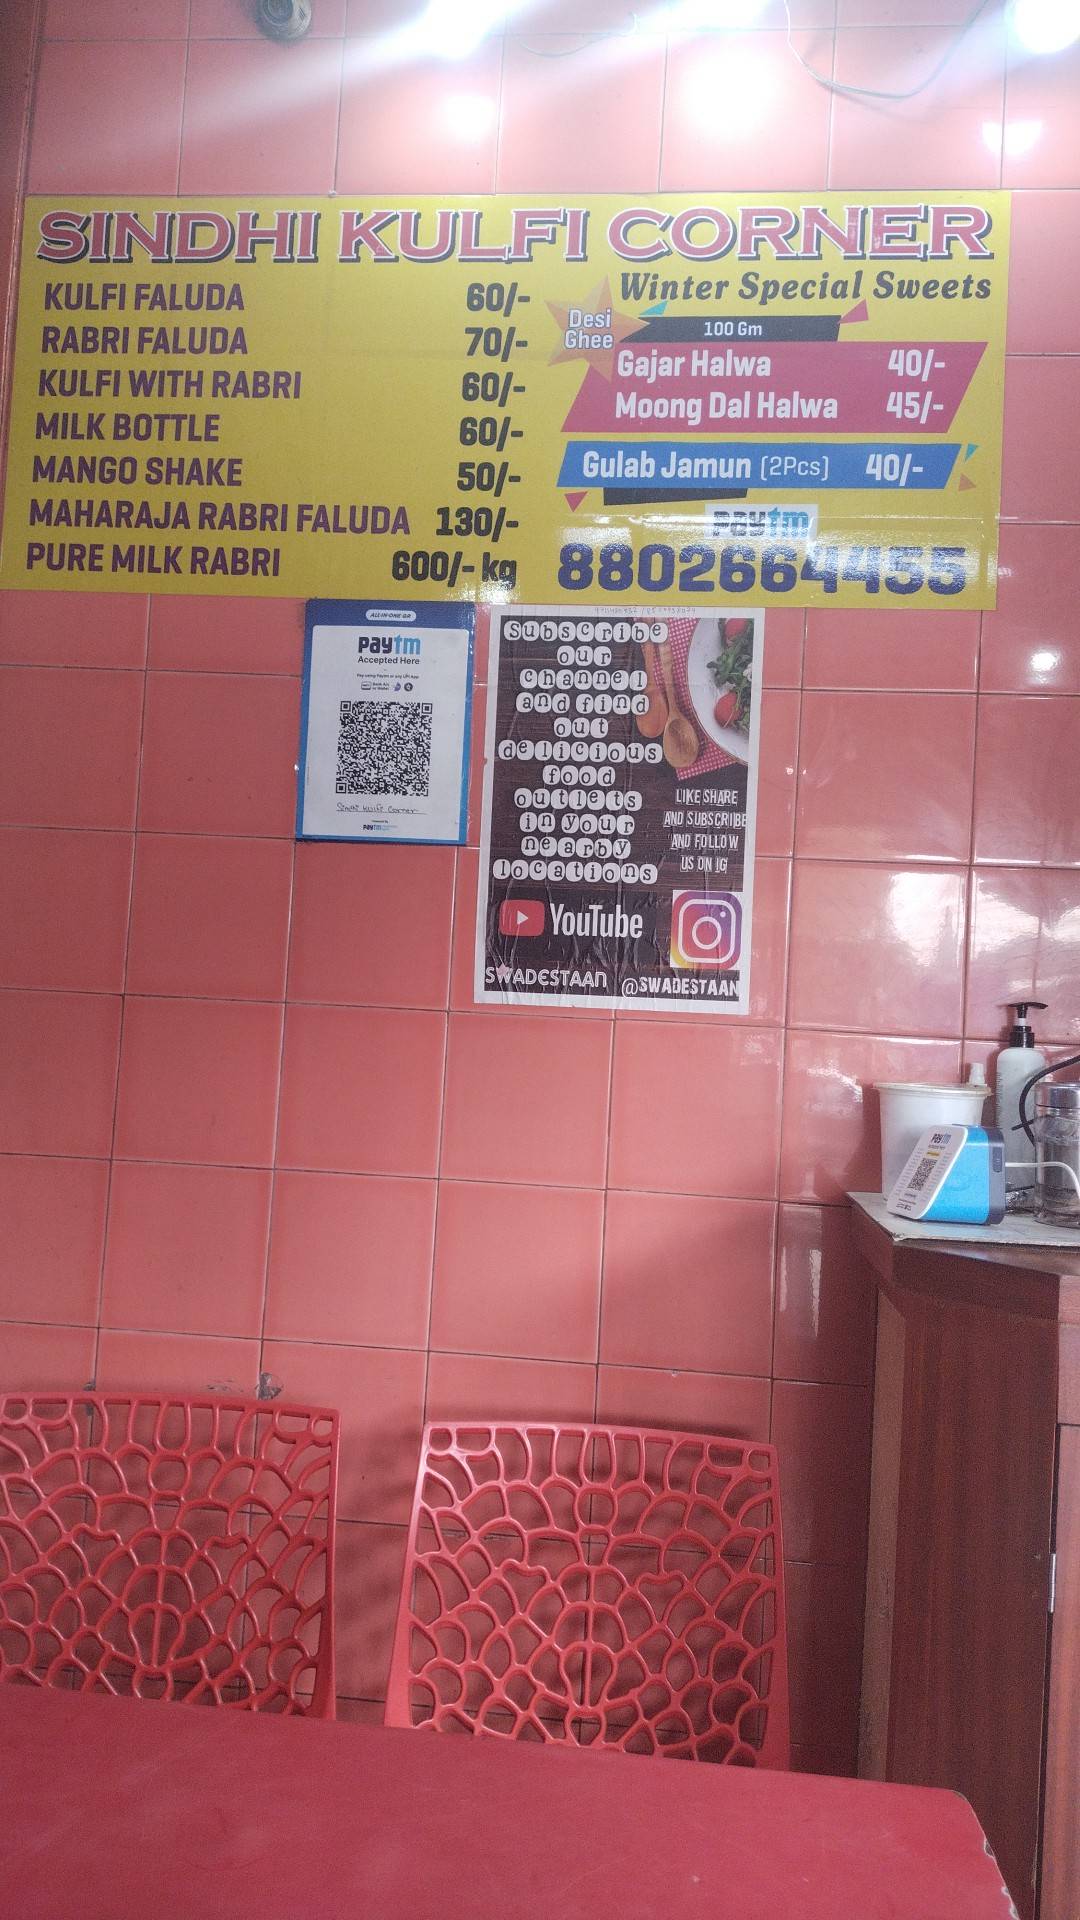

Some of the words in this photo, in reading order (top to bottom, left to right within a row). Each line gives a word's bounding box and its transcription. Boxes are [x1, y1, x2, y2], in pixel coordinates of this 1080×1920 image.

[37, 211, 321, 264] SINDHI
[338, 207, 589, 264] KULFI
[607, 203, 995, 262] CORNER
[45, 283, 126, 311] KULFI
[134, 283, 244, 311] FALUDA
[466, 282, 530, 317] 60/-
[620, 272, 729, 300] Winter
[737, 270, 863, 306] Special
[872, 270, 992, 300] Sweets
[568, 308, 612, 329] Desi
[703, 321, 735, 337] 100
[737, 321, 763, 337] Gm
[41, 326, 129, 355] RABRI
[137, 327, 248, 355] FALUDA
[465, 327, 528, 362] 70/-
[564, 330, 614, 350] Ghee
[617, 349, 686, 381] Gajar
[690, 348, 771, 377] Halwa
[888, 348, 946, 382] 40/-
[38, 369, 120, 398] KULFI
[129, 370, 204, 398] WITH
[212, 371, 302, 399] RABRI
[461, 372, 526, 407] 60/-
[615, 392, 702, 425] Moong
[708, 392, 752, 419] Dal
[756, 392, 838, 419] Halwa
[886, 391, 944, 425] 45/-
[35, 412, 105, 441] MILK
[113, 413, 219, 442] BOTTLE
[459, 416, 523, 452] 60/-
[32, 456, 137, 485] MANGO
[145, 457, 243, 487] SHAKE
[456, 462, 521, 497] 50/-
[582, 450, 656, 480] Gulab
[661, 452, 751, 480] Jamun
[865, 453, 924, 487] 40/-
[28, 499, 191, 530] MAHARAJA
[199, 502, 288, 532] RABRI
[297, 504, 411, 536] FALUDA
[435, 507, 519, 542] 130/-
[26, 542, 104, 572] PURE
[111, 545, 183, 574] MILK
[189, 547, 280, 578] RABRI
[391, 550, 475, 588] 600/-
[481, 551, 517, 590] kg
[557, 543, 966, 596] 8802664455
[503, 620, 670, 644] Subscribe
[358, 655, 399, 665] Accepted
[400, 656, 420, 665] Here
[556, 645, 612, 667] our
[519, 669, 648, 690] channel
[516, 692, 571, 714] and
[575, 694, 650, 716] find
[553, 717, 609, 738] out
[498, 739, 663, 764] delicious
[542, 764, 616, 786] food
[514, 788, 643, 811] outlets
[675, 788, 701, 805] LIKE
[702, 789, 739, 806] SHARE
[519, 812, 556, 833] in
[561, 813, 635, 836] your
[663, 811, 684, 828] AND
[686, 811, 748, 830] SUBSCRIBE
[520, 836, 631, 860] nearby
[670, 833, 691, 850] AND
[694, 834, 739, 851] FOLLOW
[493, 858, 659, 885] locations
[680, 855, 694, 872] US
[697, 856, 712, 872] ON
[714, 857, 728, 873] IG
[550, 902, 643, 938] YouTube
[621, 976, 741, 999] @SWADESTAAN
